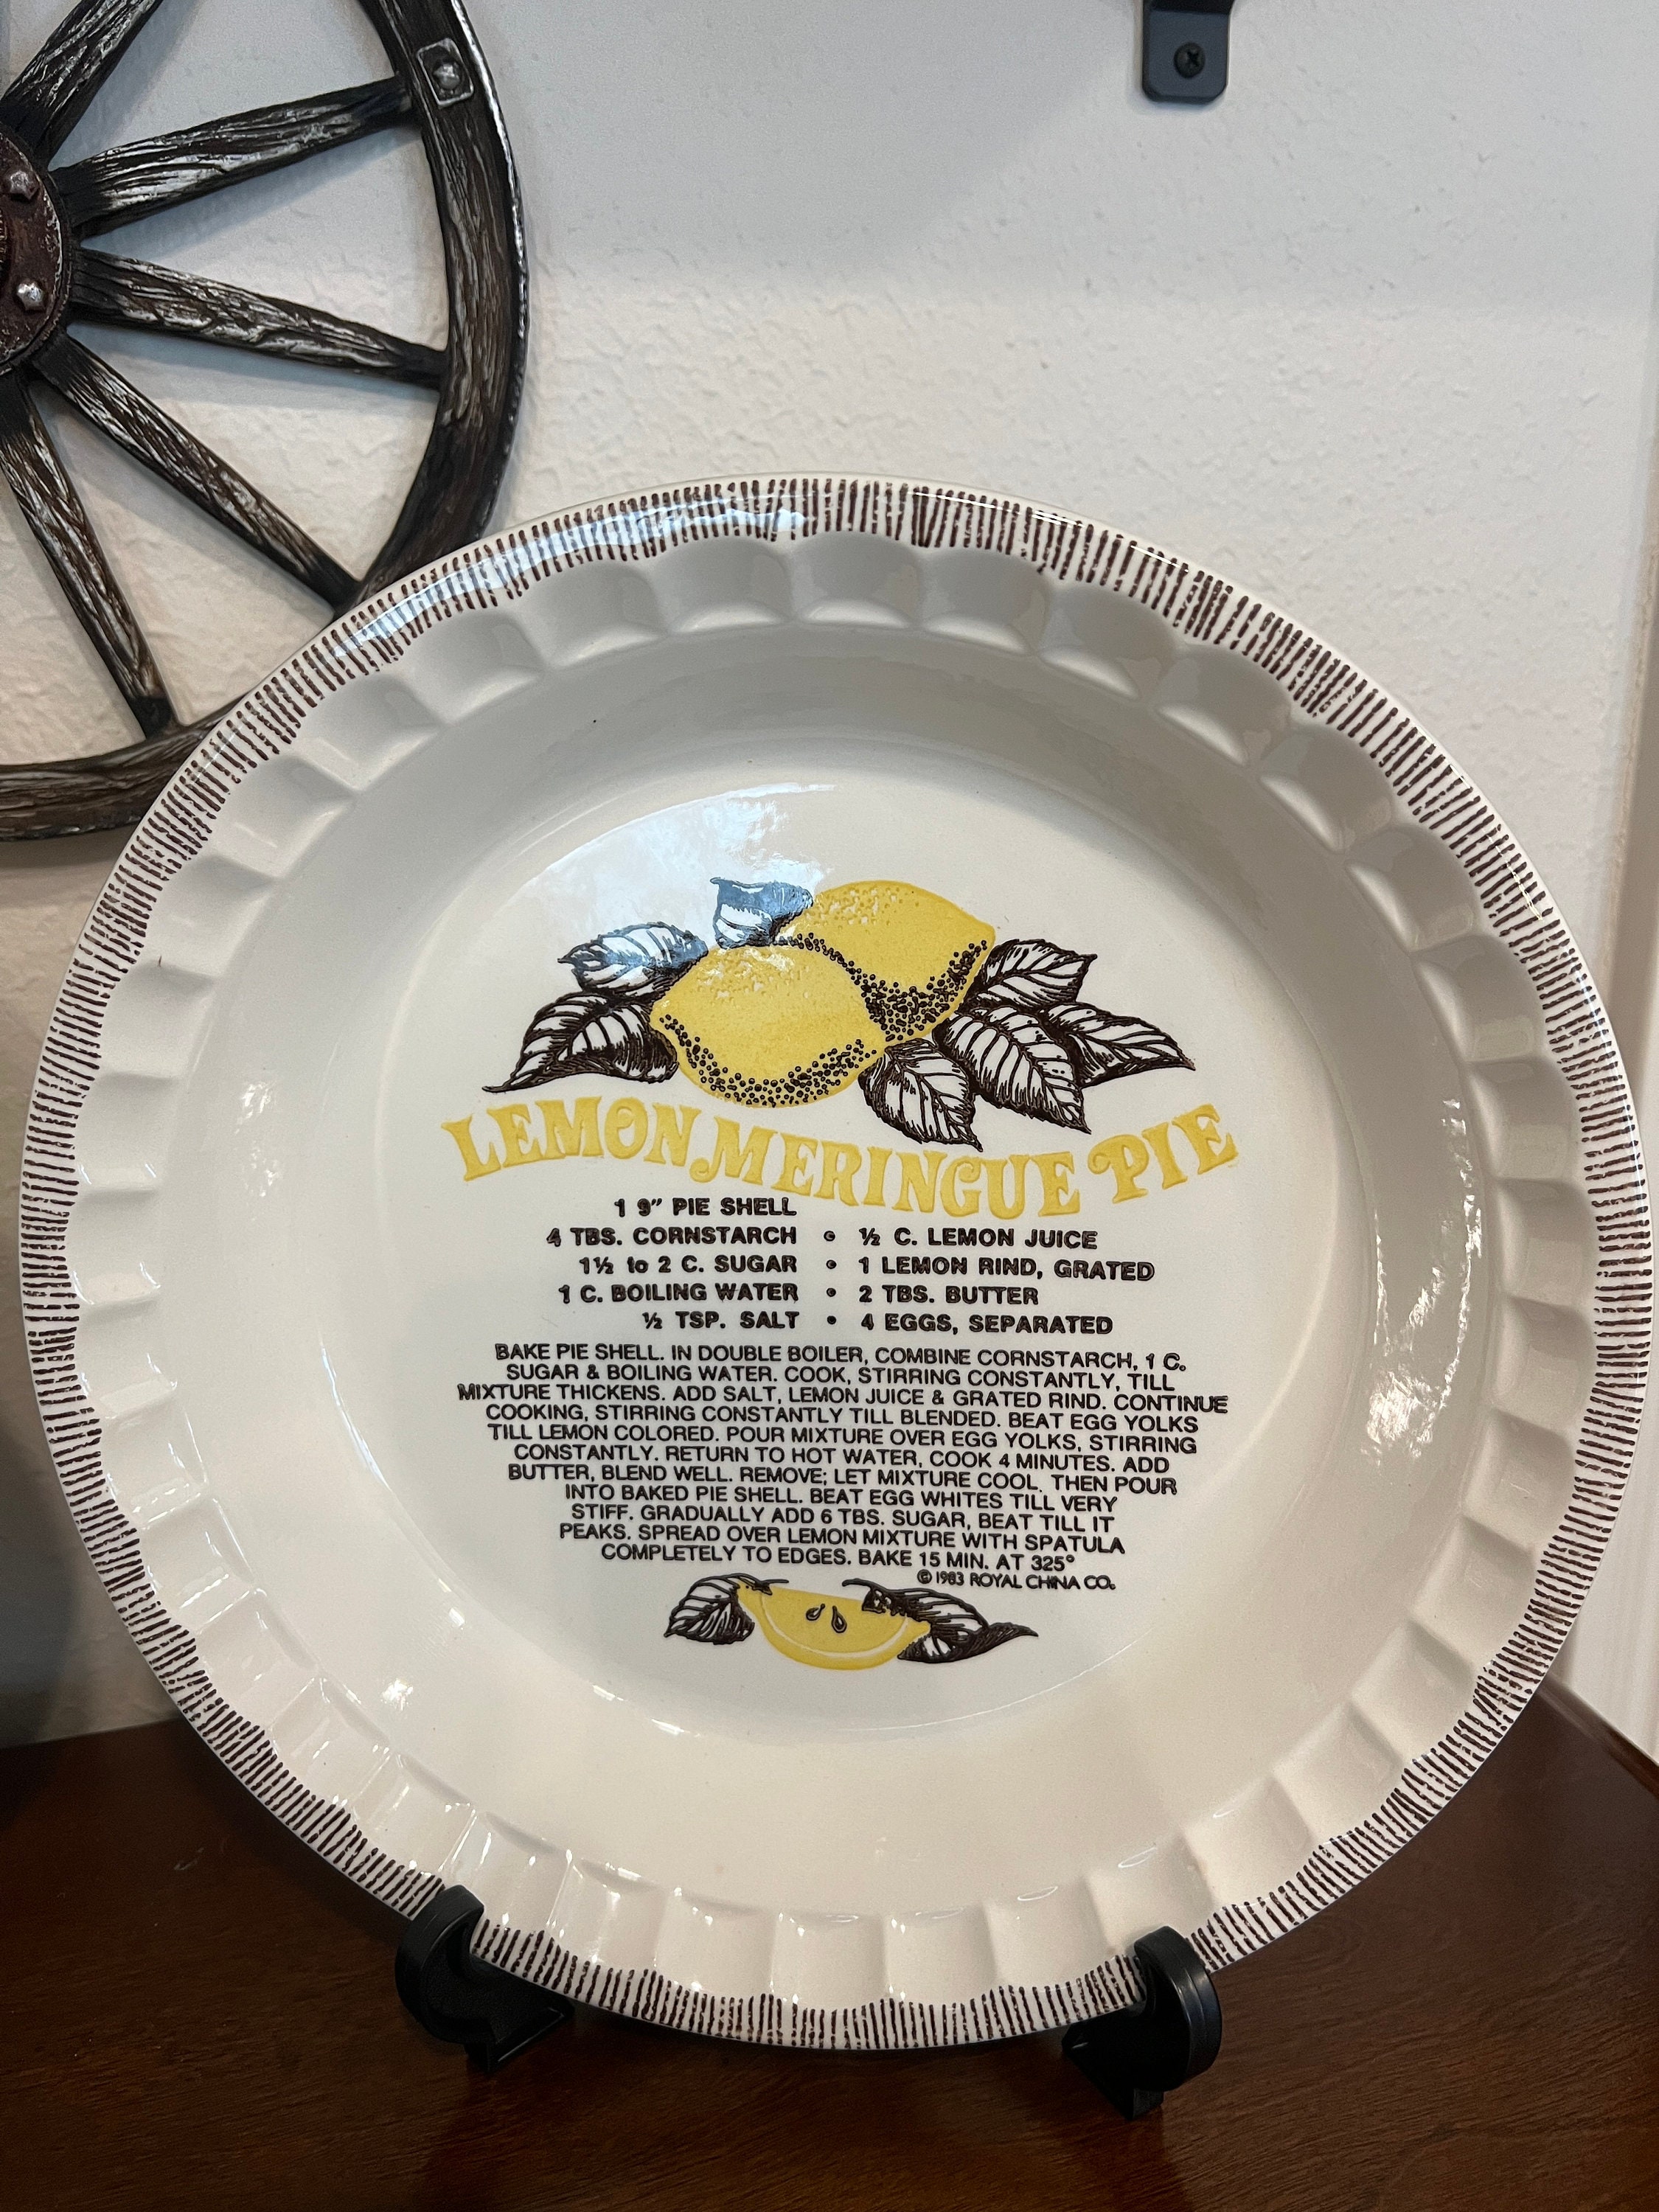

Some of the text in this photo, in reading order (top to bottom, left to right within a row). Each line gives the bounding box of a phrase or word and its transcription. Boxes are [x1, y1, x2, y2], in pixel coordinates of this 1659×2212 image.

[441, 1096, 1239, 1220] LEMON MERINGUE PIE
[614, 1198, 625, 1218] 1
[672, 1197, 710, 1216] PIE
[720, 1197, 797, 1216] SHELL
[546, 1226, 796, 1248] 4 TBS. CORNSTARCH
[894, 1227, 917, 1246] C.
[928, 1228, 1014, 1247] LEMON
[1025, 1229, 1098, 1250] JUICE
[627, 1256, 649, 1273] to
[658, 1256, 671, 1273] 2
[681, 1255, 704, 1273] C.
[714, 1254, 797, 1273] SUGAR
[858, 1256, 1155, 1281] 1 LEMON RIND, GRATED
[558, 1283, 799, 1304] 1 C. BOILING WATER
[859, 1284, 1038, 1305] 2 TBS. BUTTER
[675, 1311, 726, 1329] TSP.
[740, 1311, 799, 1329] SALT
[861, 1313, 1113, 1335] 4 EGGS, SEPARATED
[495, 1343, 1186, 1372] BAKE PIE SHELL. IN DOUBLE BOILER, COMBINE CORNSTARCH, 1 C.
[507, 1363, 1175, 1392] SUGAR & BOILING WATER. COOK, STIRRING CONSTANTLY, TILL
[457, 1383, 1228, 1414] MIXTURE THICKENS. ADD SALT, LEMON JUICE & GRATED RIND. CONTINUE
[486, 1404, 1198, 1433] COOKING, STIRRING CONSTANTLY TILL BLENDED. BEAT EGG YOLKS
[487, 1423, 1197, 1454] TILL LEMON COLORED. POUR MIXTURE OVER EGG YOLKS, STIRRING
[514, 1444, 1169, 1474] CONSTANTLY. RETURN TO HOT WATER, COOK 4 MINUTES. ADD
[508, 1464, 594, 1482] BUTTER,
[602, 1464, 667, 1481] BLEND
[673, 1466, 732, 1482] WELL.
[740, 1467, 827, 1486] REMOVE;
[835, 1468, 872, 1485] LET
[877, 1470, 971, 1488] MIXTURE
[1051, 1474, 1107, 1492] THEN
[1115, 1476, 1178, 1495] POUR
[566, 1484, 1118, 1512] INTO BAKED PIE SHELL. BEAT EGG WHITES TILL VERY
[571, 1503, 1115, 1533] STIFF. GRADUALLY ADD 6 TBS. SUGAR, BEAT TILL IT
[560, 1523, 1125, 1554] PEAKS. SPREAD OVER LEMON MIXTURE WITH SPATULA
[602, 1543, 736, 1561] COMPLETELY
[742, 1545, 772, 1563] TO
[778, 1547, 852, 1565] EDGES.
[858, 1549, 912, 1567] BAKE
[919, 1551, 941, 1568] 15
[947, 1551, 989, 1570] MIN.
[996, 1554, 1025, 1571] AT
[936, 1571, 964, 1586] 1983
[970, 1572, 1023, 1589] ROYAL
[1026, 1574, 1081, 1590] CHINA
[1084, 1575, 1116, 1590] CO.
